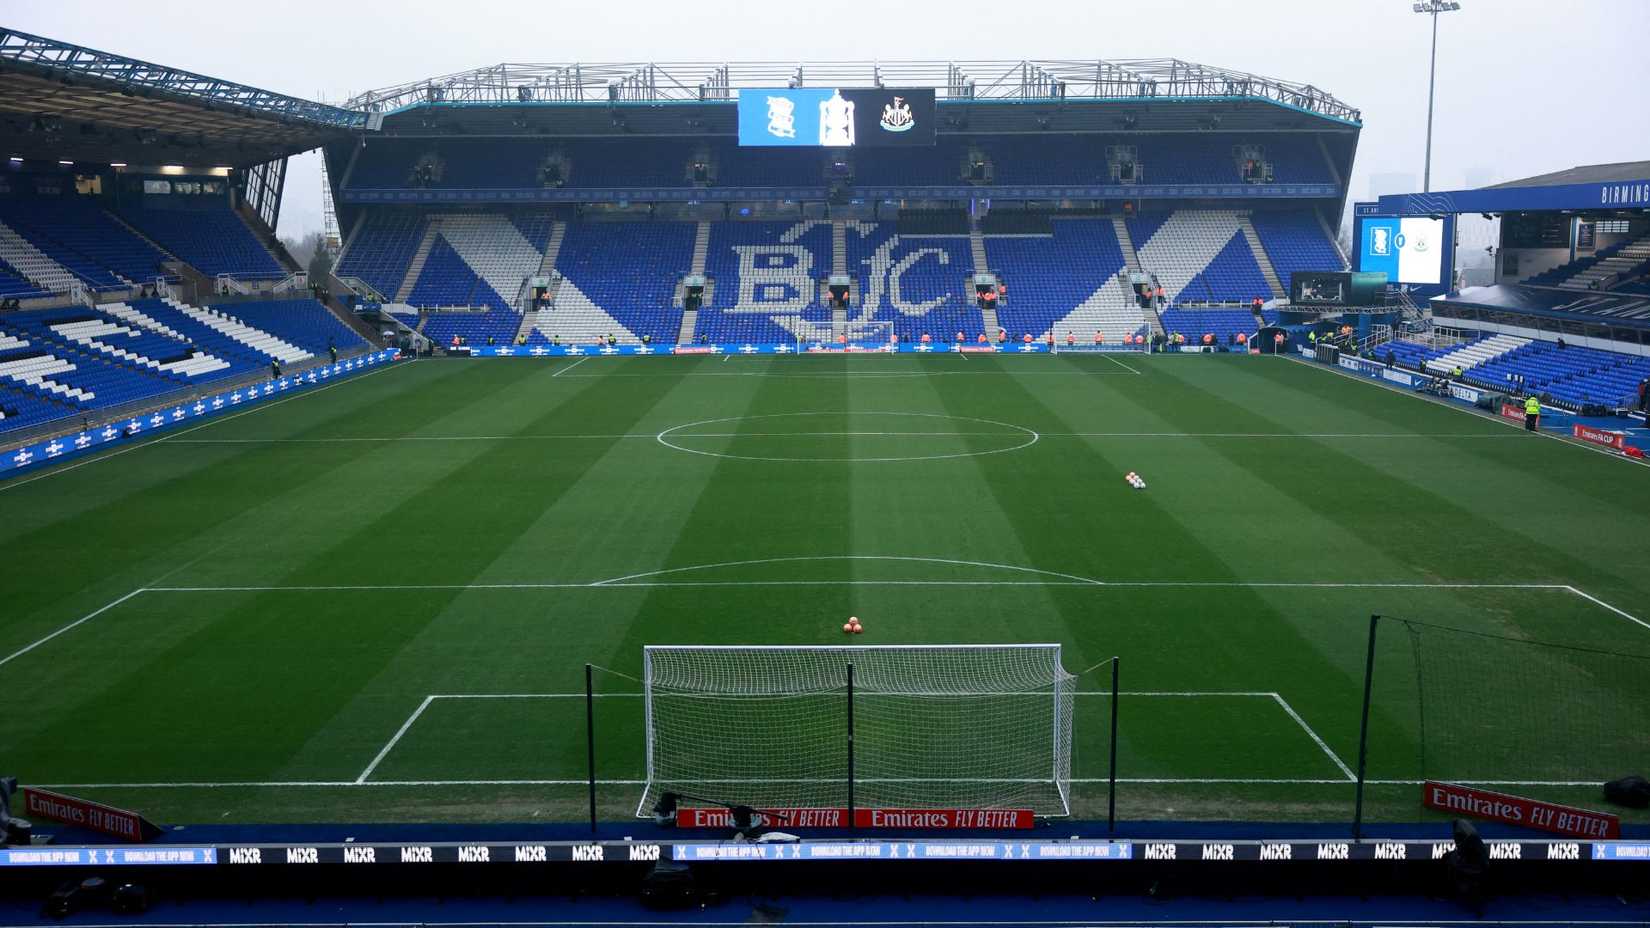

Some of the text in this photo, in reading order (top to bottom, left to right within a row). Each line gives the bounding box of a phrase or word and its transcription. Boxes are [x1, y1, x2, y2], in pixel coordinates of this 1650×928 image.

[1601, 184, 1649, 203] BIRMING
[29, 794, 134, 834] Emirates FLY BETTER
[777, 811, 797, 827] FLY
[800, 811, 839, 827] BETTER
[872, 810, 1017, 828] Emirates FLY BETTER
[1432, 787, 1608, 838] Emirates FLY BETTER
